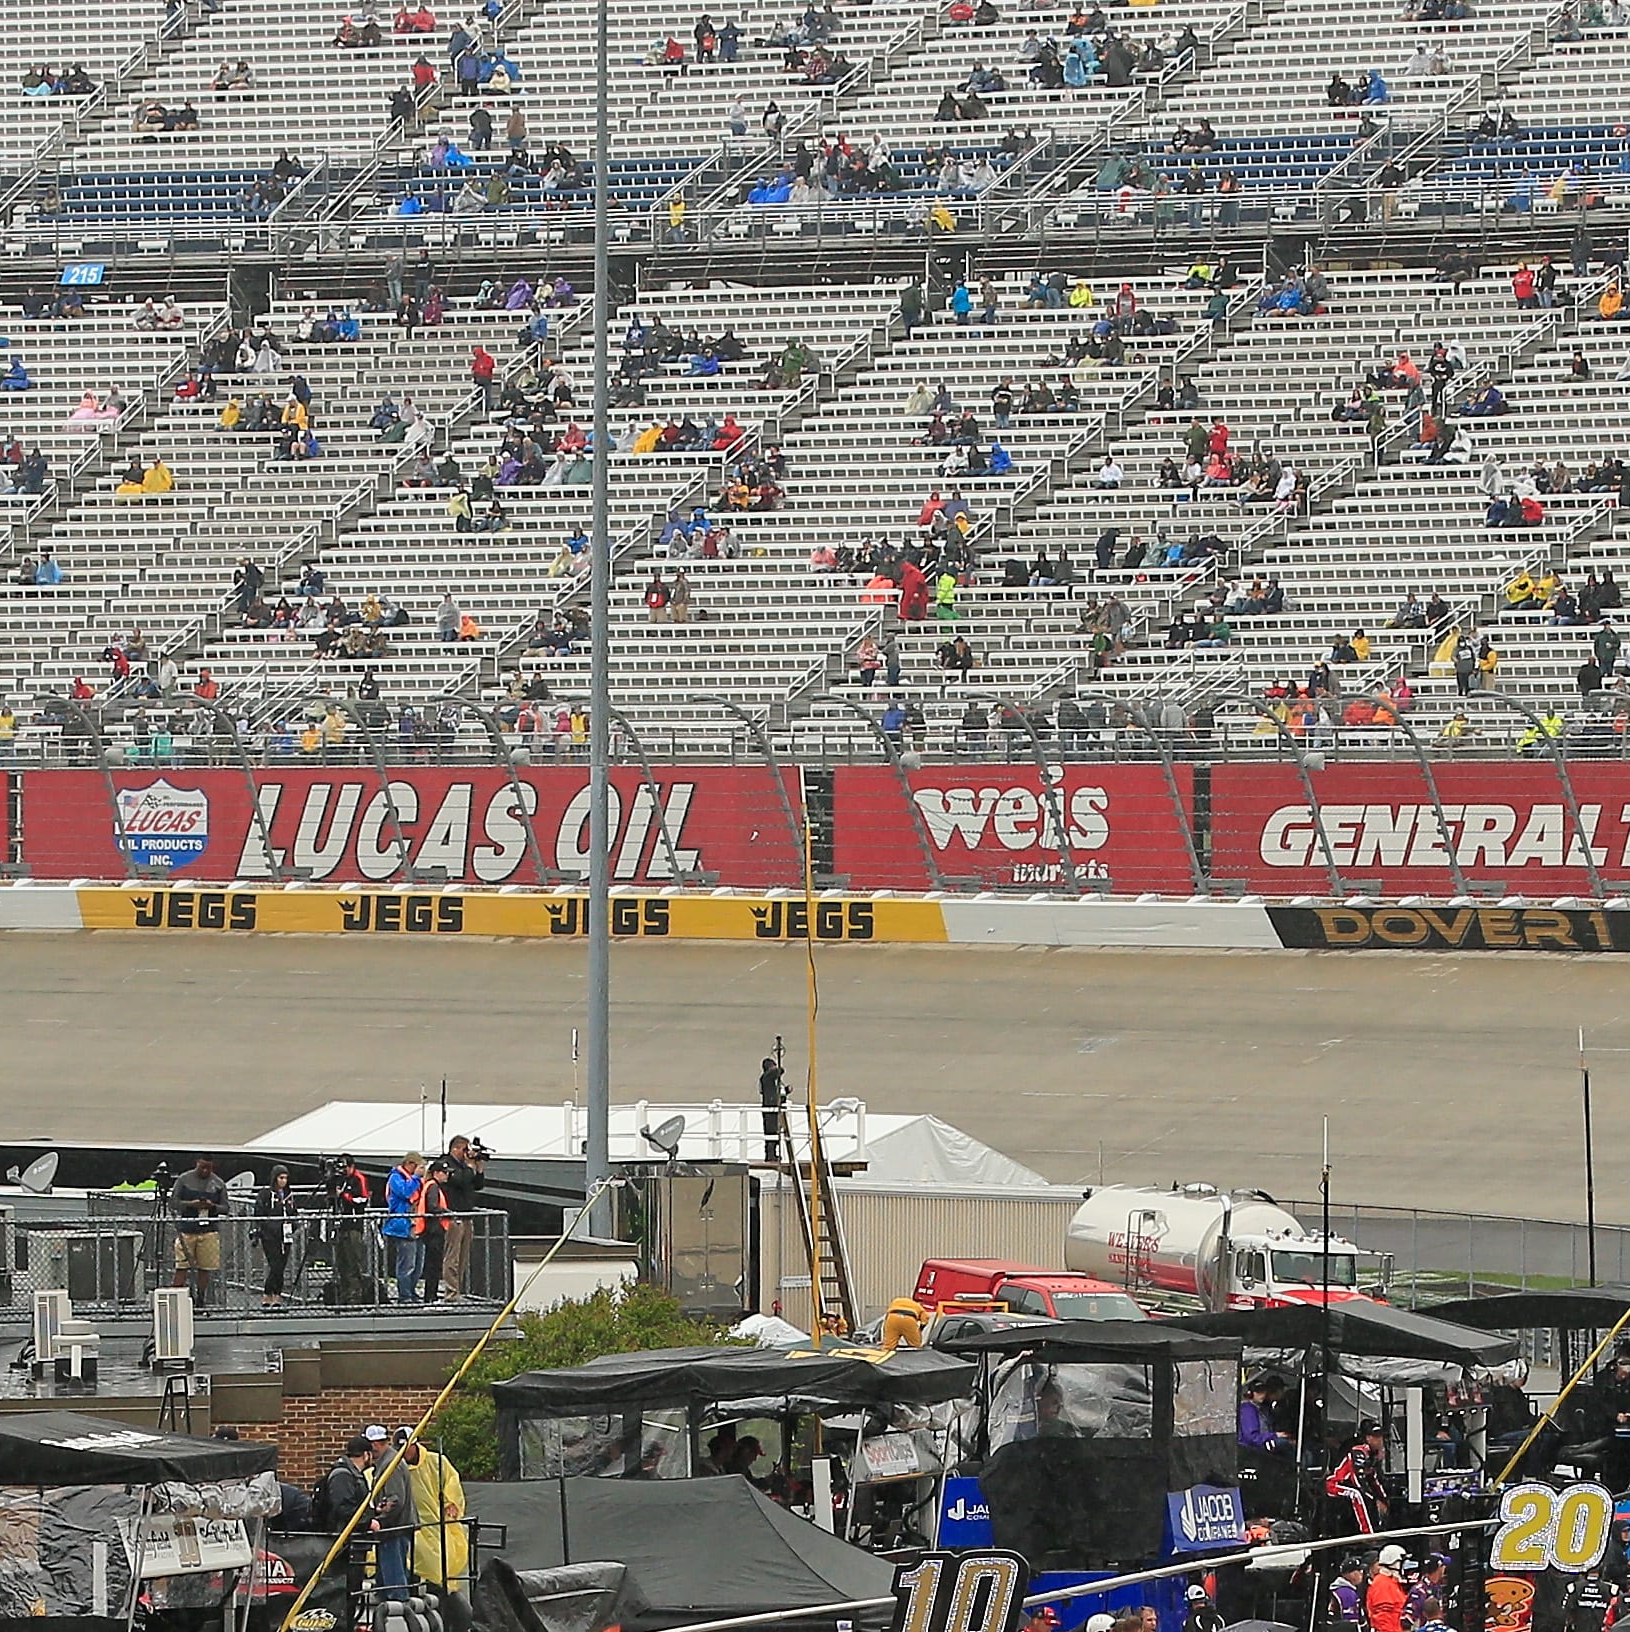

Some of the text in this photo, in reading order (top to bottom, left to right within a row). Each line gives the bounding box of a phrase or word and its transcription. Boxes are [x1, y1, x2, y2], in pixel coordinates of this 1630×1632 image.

[69, 268, 98, 283] 215
[124, 810, 202, 832] LUCAS
[913, 766, 1109, 850] weis
[141, 839, 203, 851] PRODUCTS
[237, 781, 702, 882] LUCAS OIL
[1261, 803, 1609, 868] GENERAL
[149, 855, 173, 866] INC.
[135, 894, 257, 929] JEGS
[341, 896, 464, 932] JEGS
[754, 902, 875, 939] JEGS
[1322, 908, 1572, 945] DOVER
[1195, 1493, 1235, 1522] JACOB
[1491, 1484, 1613, 1572] 20
